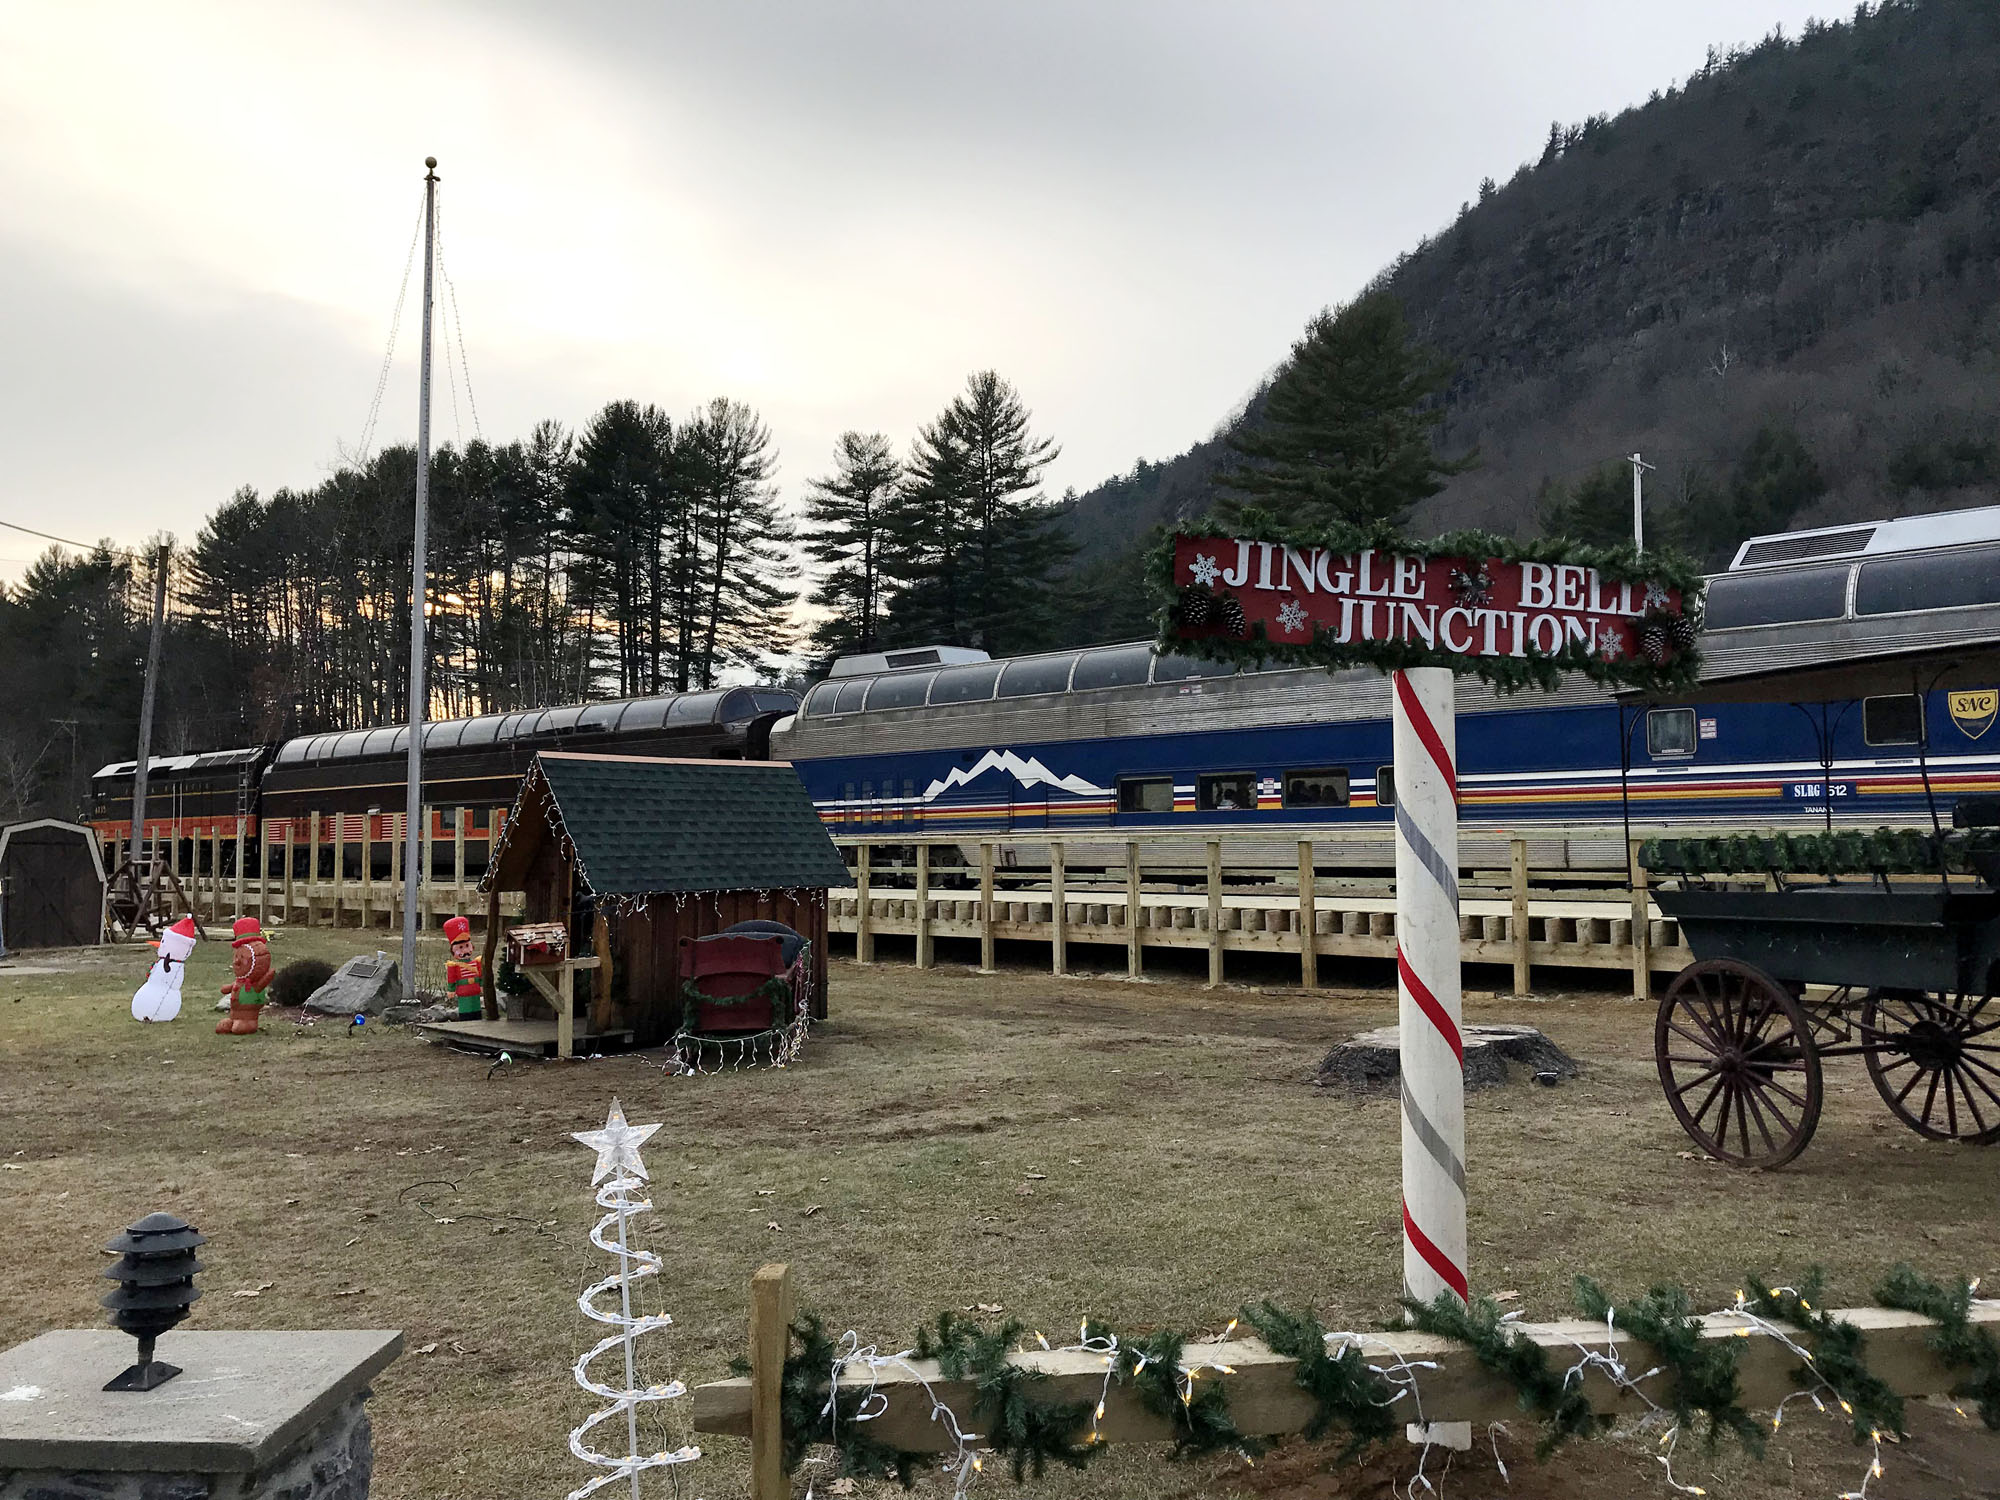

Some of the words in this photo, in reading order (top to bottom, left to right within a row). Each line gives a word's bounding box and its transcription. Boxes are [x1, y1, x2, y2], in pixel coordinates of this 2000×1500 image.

[1222, 539, 1426, 600] JINGLE
[1517, 561, 1646, 617] BELL
[1335, 597, 1600, 659] JUNCTION
[1794, 785, 1820, 797] SLRG
